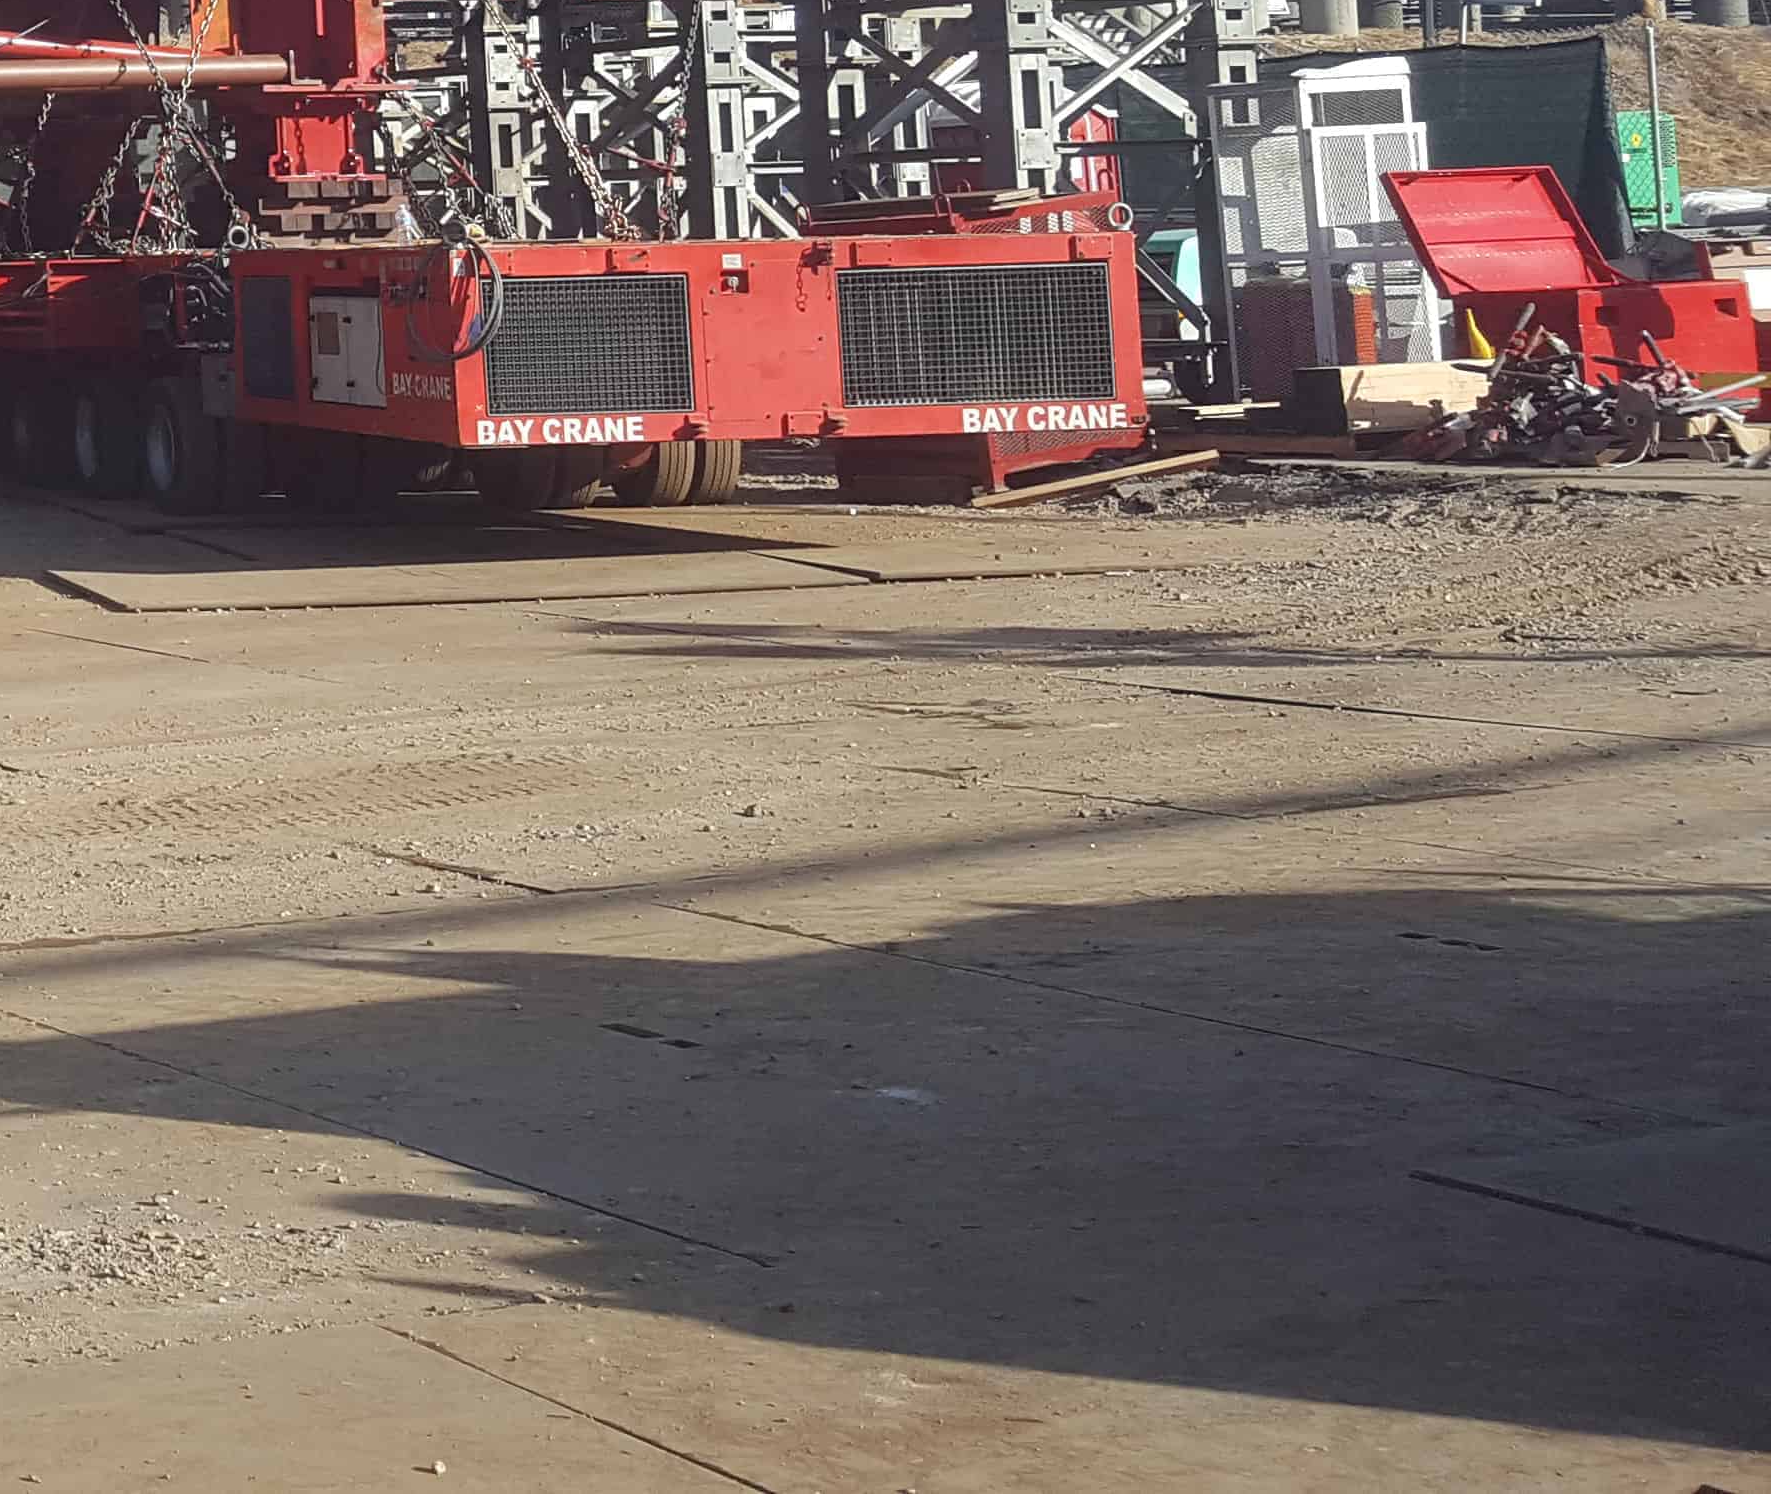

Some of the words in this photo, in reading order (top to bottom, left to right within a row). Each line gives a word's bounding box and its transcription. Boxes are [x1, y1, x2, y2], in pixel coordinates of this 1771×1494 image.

[392, 372, 414, 396] BAY
[414, 374, 452, 401] CRANE
[476, 418, 536, 445] BAY
[542, 416, 645, 444] CRANE
[962, 407, 1019, 434] BAY
[1027, 403, 1128, 431] CRANE
